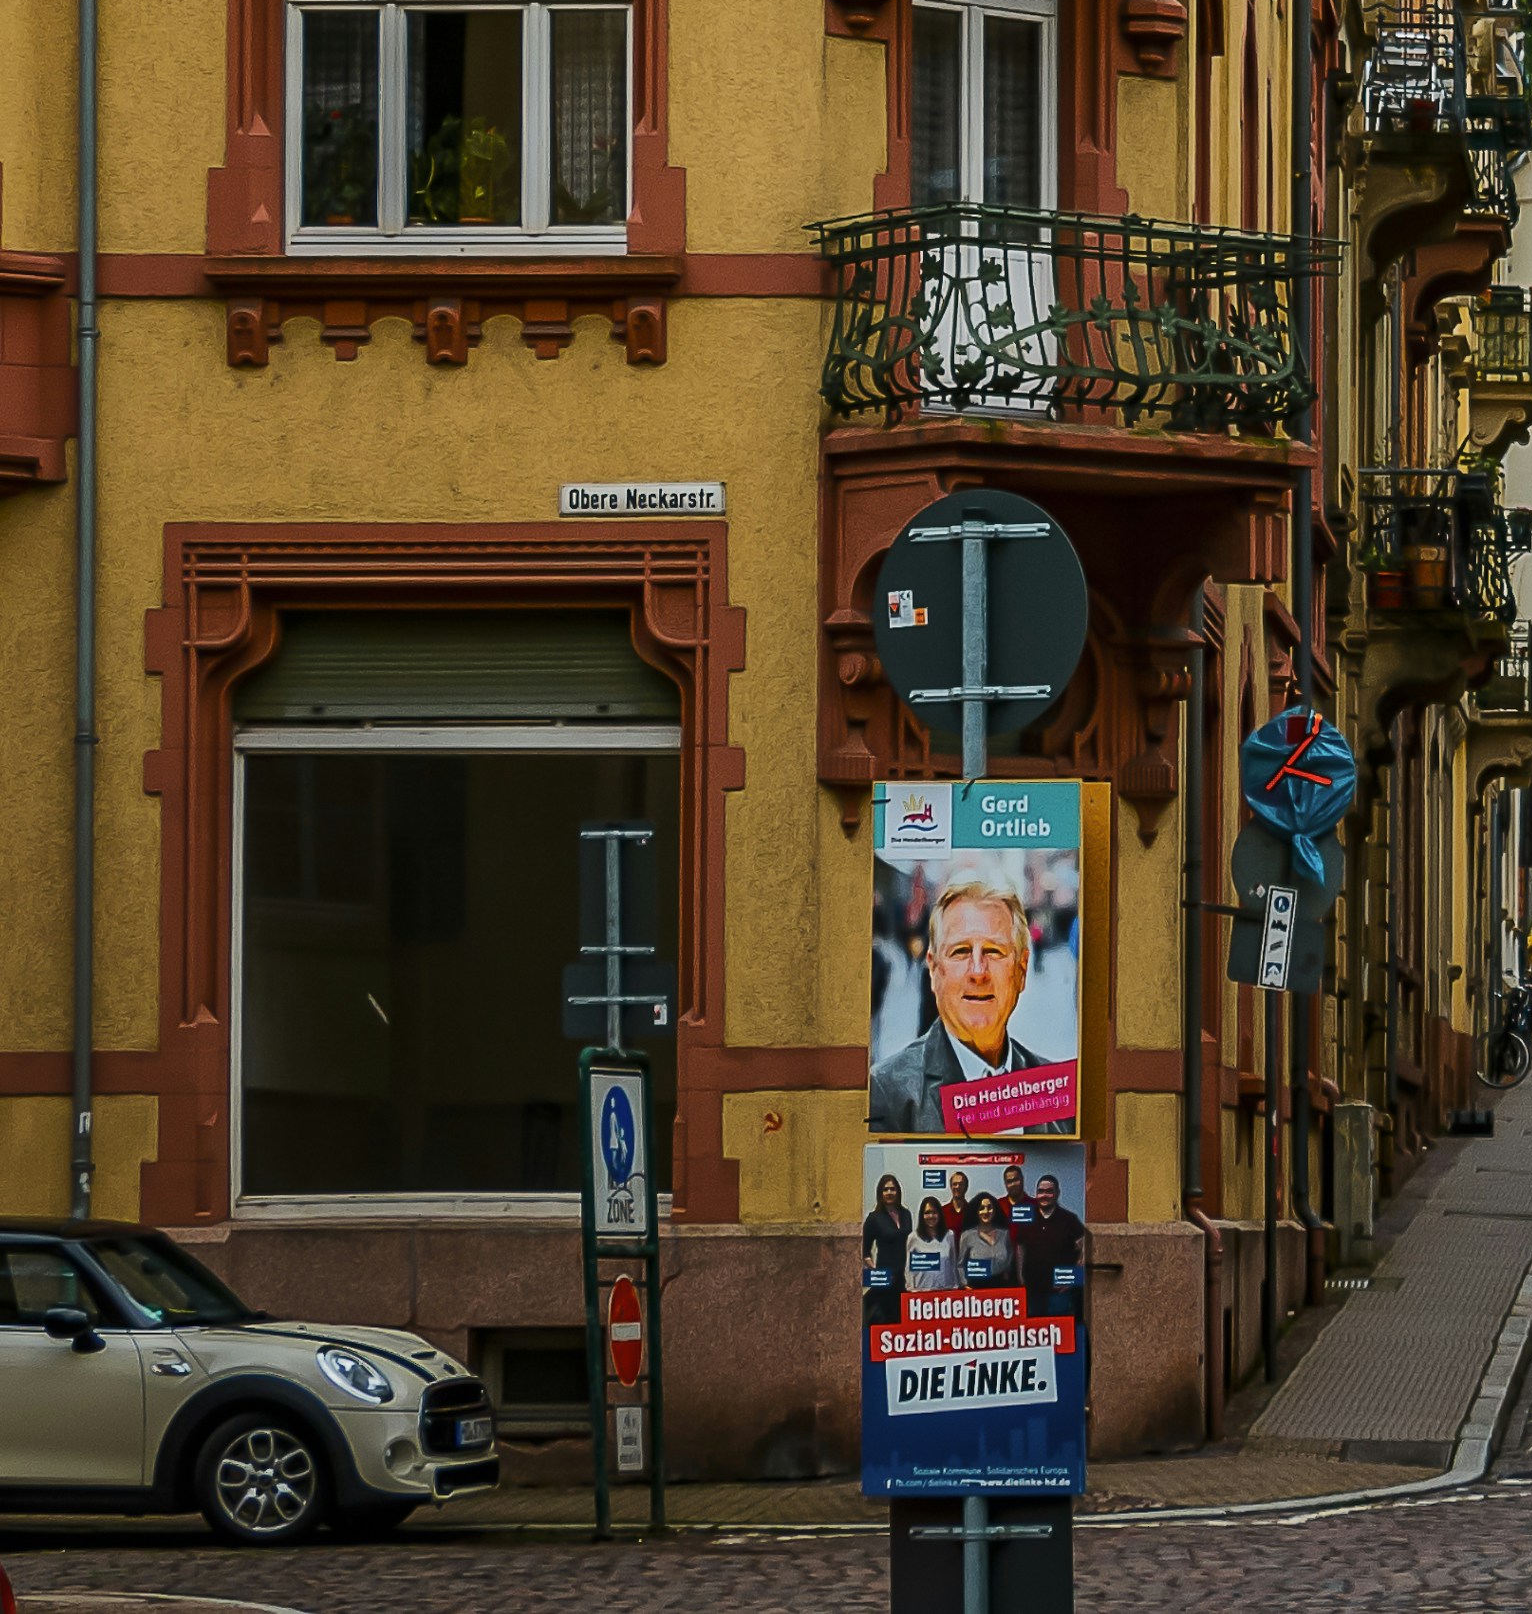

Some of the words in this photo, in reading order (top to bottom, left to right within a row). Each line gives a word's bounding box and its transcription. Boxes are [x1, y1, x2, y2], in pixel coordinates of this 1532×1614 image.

[569, 488, 618, 510] Obere
[626, 488, 716, 509] Neckarstr.
[981, 794, 1029, 814] Gerd
[981, 818, 1051, 837] Ortlieb
[953, 1094, 977, 1109] Die
[978, 1075, 1070, 1105] Heidelberger
[979, 1105, 1000, 1122] und
[1003, 1094, 1070, 1116] unabhängig
[606, 1197, 635, 1224] ZONE
[909, 1295, 1020, 1321] Heidelberg:
[880, 1324, 1062, 1354] Sozial-ökologisch
[898, 1365, 947, 1403] DIE
